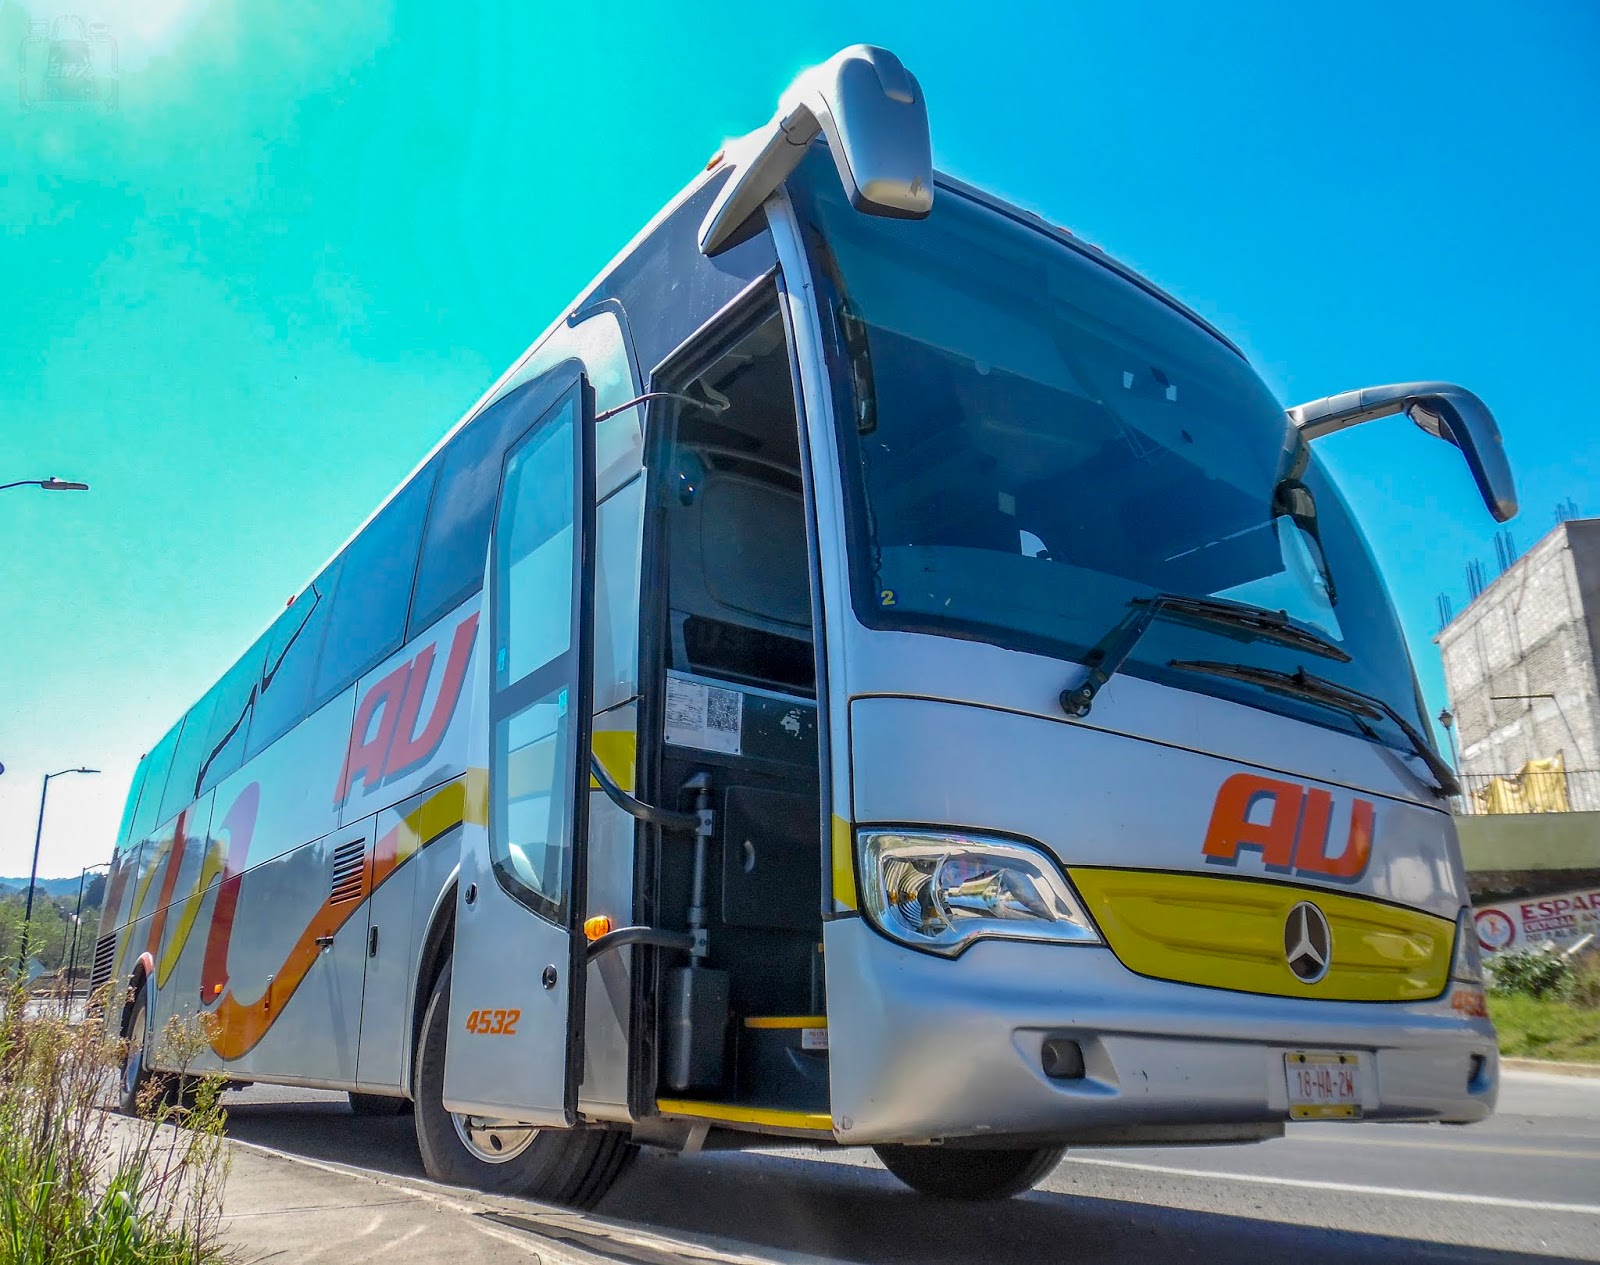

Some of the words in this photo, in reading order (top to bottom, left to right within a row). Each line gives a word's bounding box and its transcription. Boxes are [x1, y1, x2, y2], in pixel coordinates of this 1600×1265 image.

[881, 590, 896, 606] 2
[332, 610, 481, 812] AU
[1201, 772, 1377, 885] AU
[465, 1008, 522, 1036] 4532
